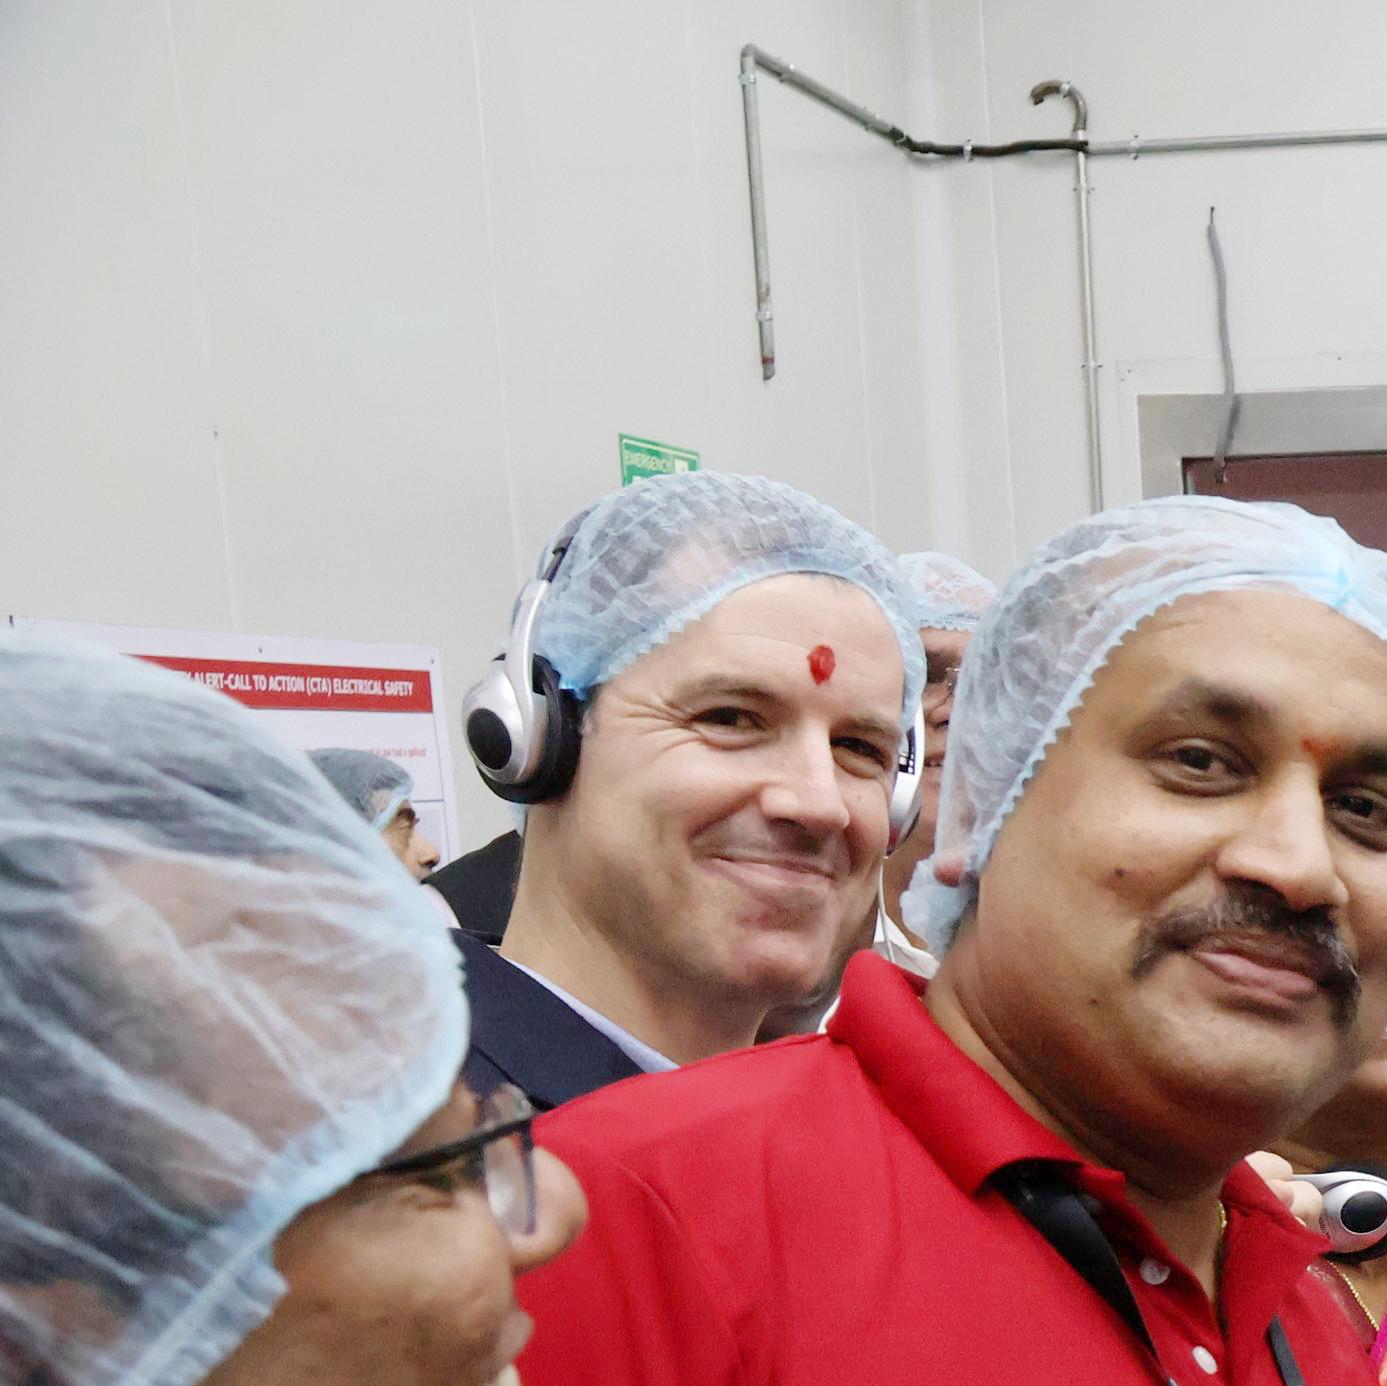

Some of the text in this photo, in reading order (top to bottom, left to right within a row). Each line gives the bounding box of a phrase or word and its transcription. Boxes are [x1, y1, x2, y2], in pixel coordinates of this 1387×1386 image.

[252, 674, 266, 691] TO
[268, 675, 304, 692] ACTION
[306, 676, 331, 696] (CTA)
[333, 678, 382, 695] ELECTRICAL
[383, 680, 413, 696] SAFETY
